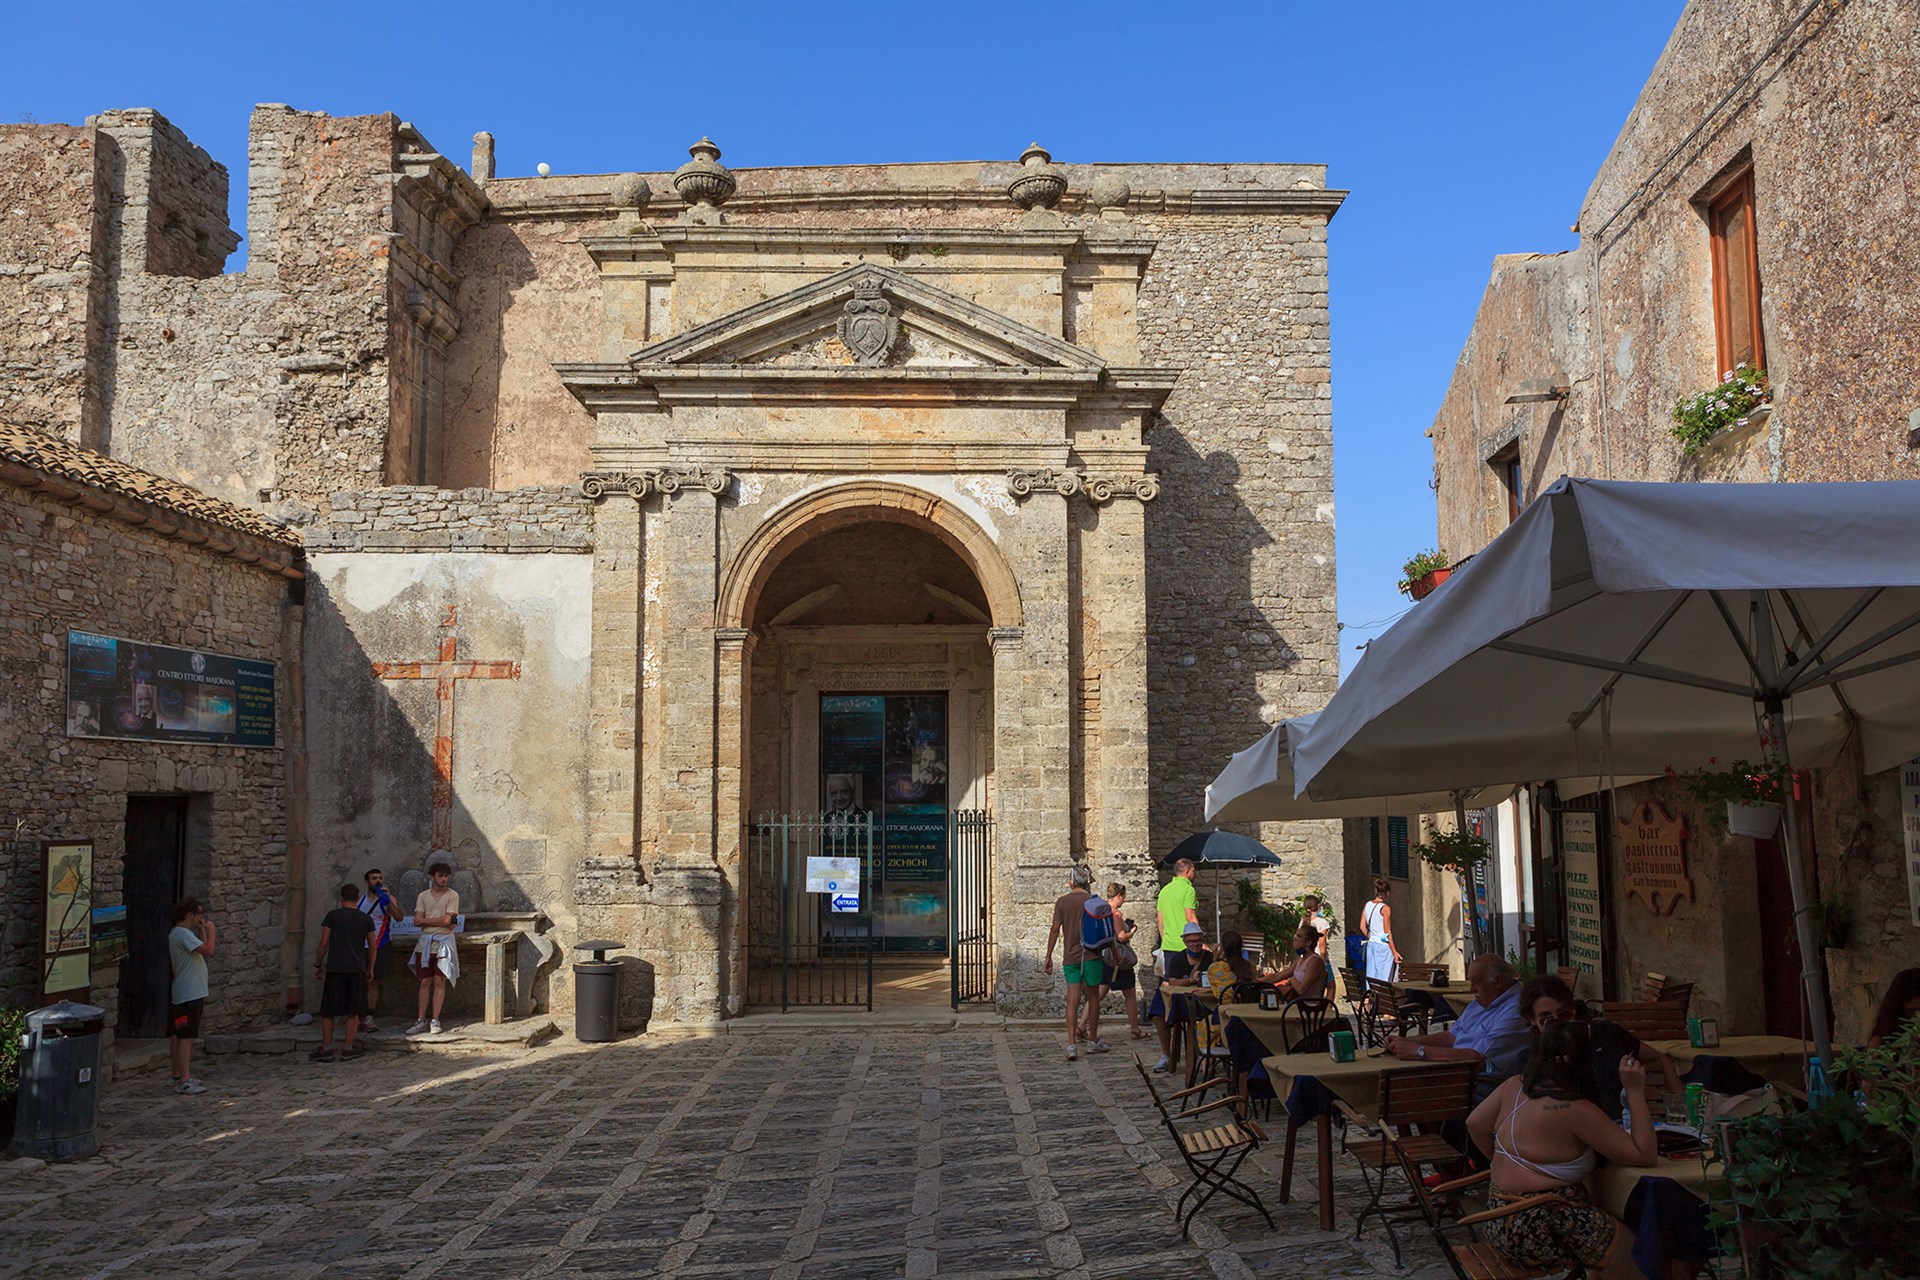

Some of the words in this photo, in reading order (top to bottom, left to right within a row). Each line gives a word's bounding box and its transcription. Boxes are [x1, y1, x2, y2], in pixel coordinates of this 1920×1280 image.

[157, 669, 184, 680] CENTRO
[184, 672, 205, 683] ETTORE
[1638, 825, 1660, 840] bar
[1625, 843, 1680, 859] pasticceria
[887, 858, 928, 867] ZICHICHI
[1626, 860, 1682, 876] gastronomia
[1567, 871, 1588, 884] PIZZE
[1633, 877, 1646, 887] san
[1646, 876, 1678, 888] domenico
[1568, 900, 1593, 914] PANINI
[1569, 930, 1599, 946] INSALATE
